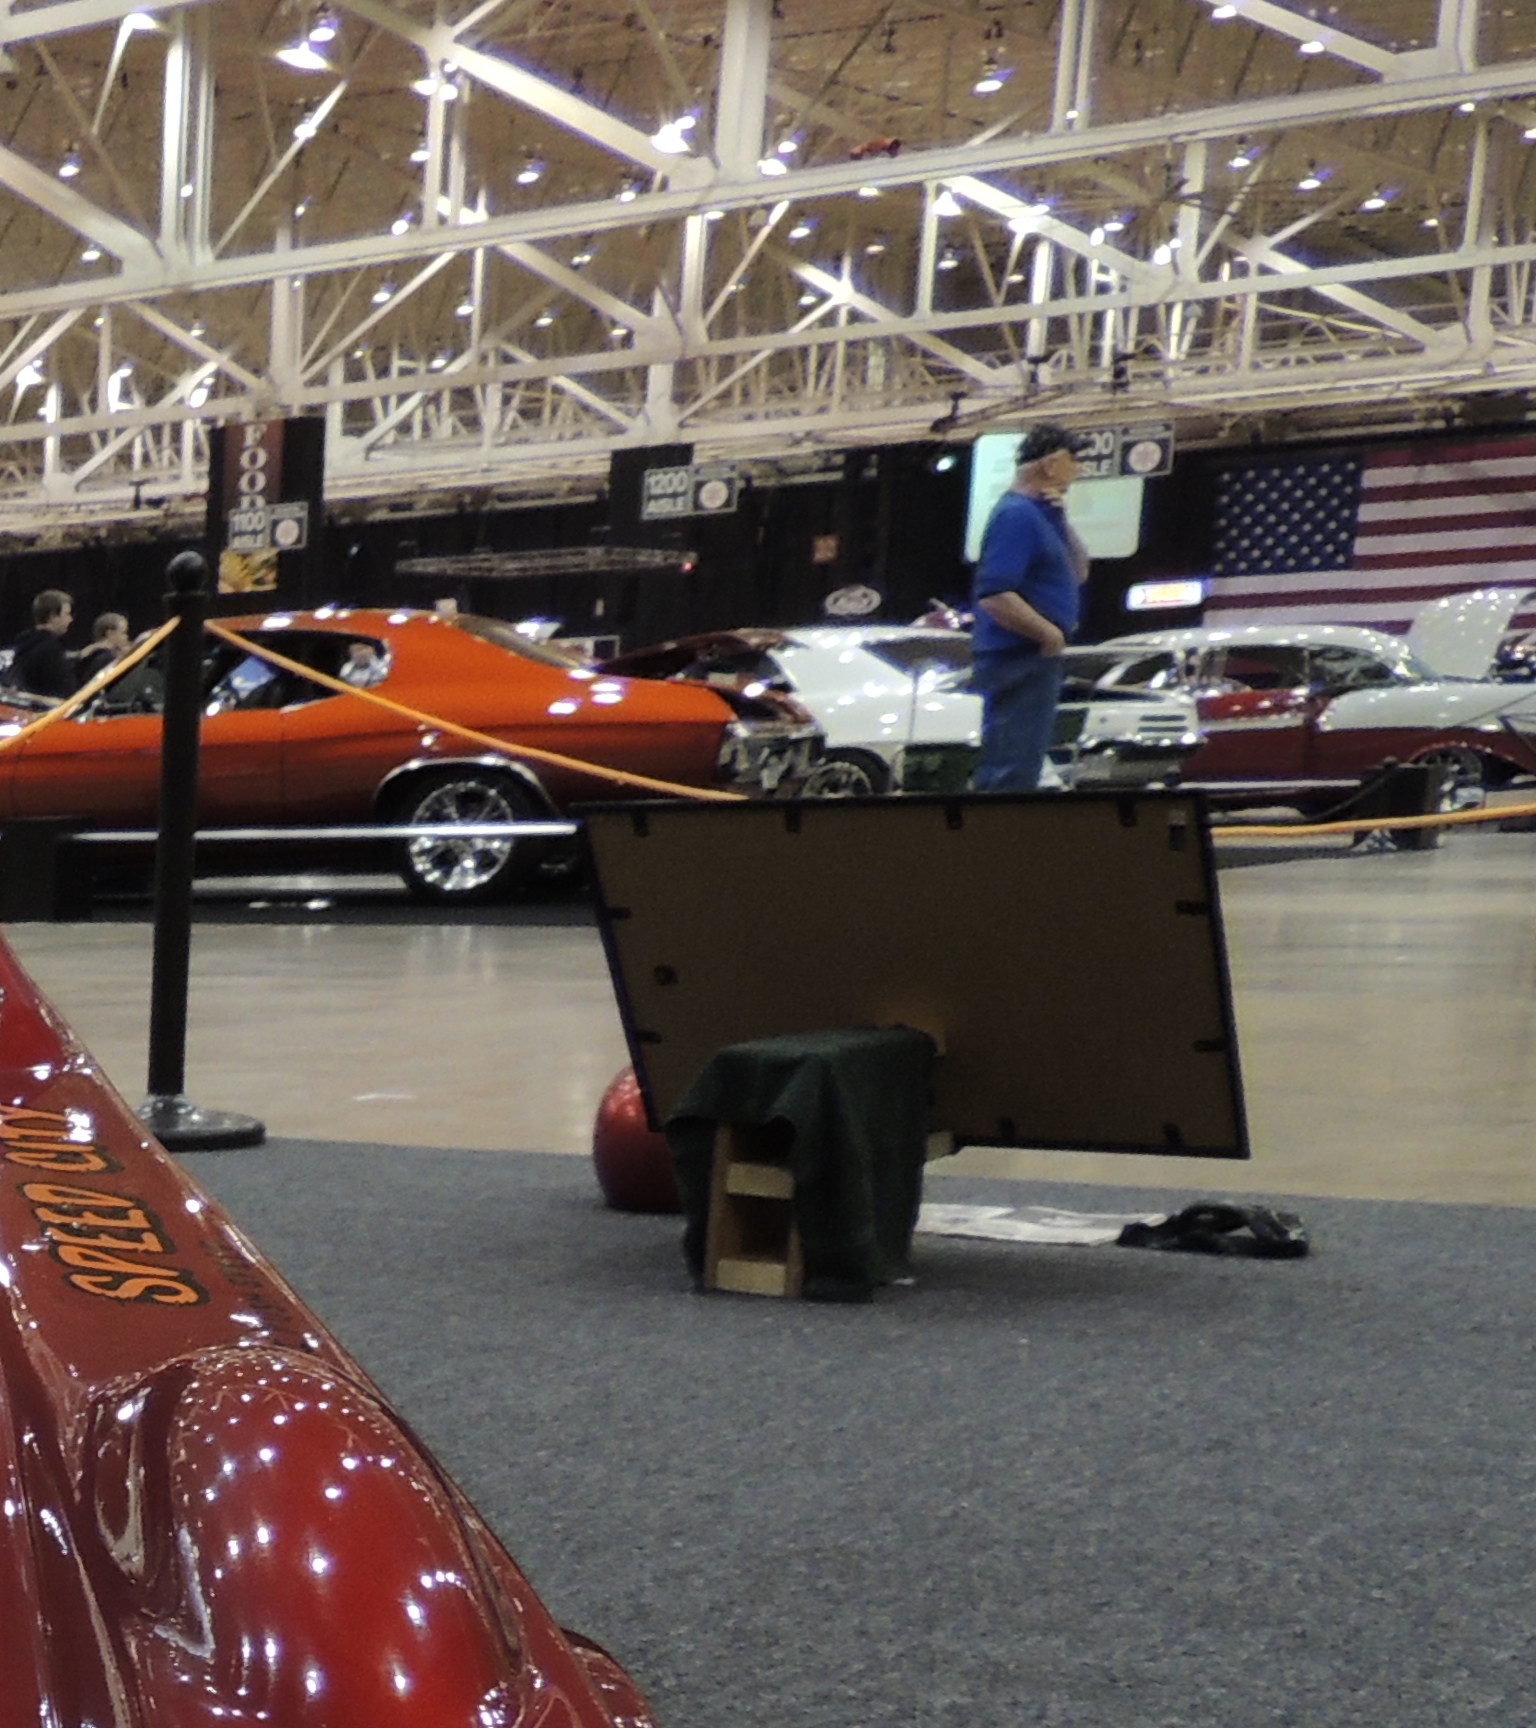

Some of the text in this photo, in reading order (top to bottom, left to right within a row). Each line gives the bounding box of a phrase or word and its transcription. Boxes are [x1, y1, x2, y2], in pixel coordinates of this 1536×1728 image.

[239, 424, 268, 509] FOOD
[648, 471, 688, 494] 1200
[232, 511, 265, 532] 1100
[21, 1182, 204, 1305] SPEED
